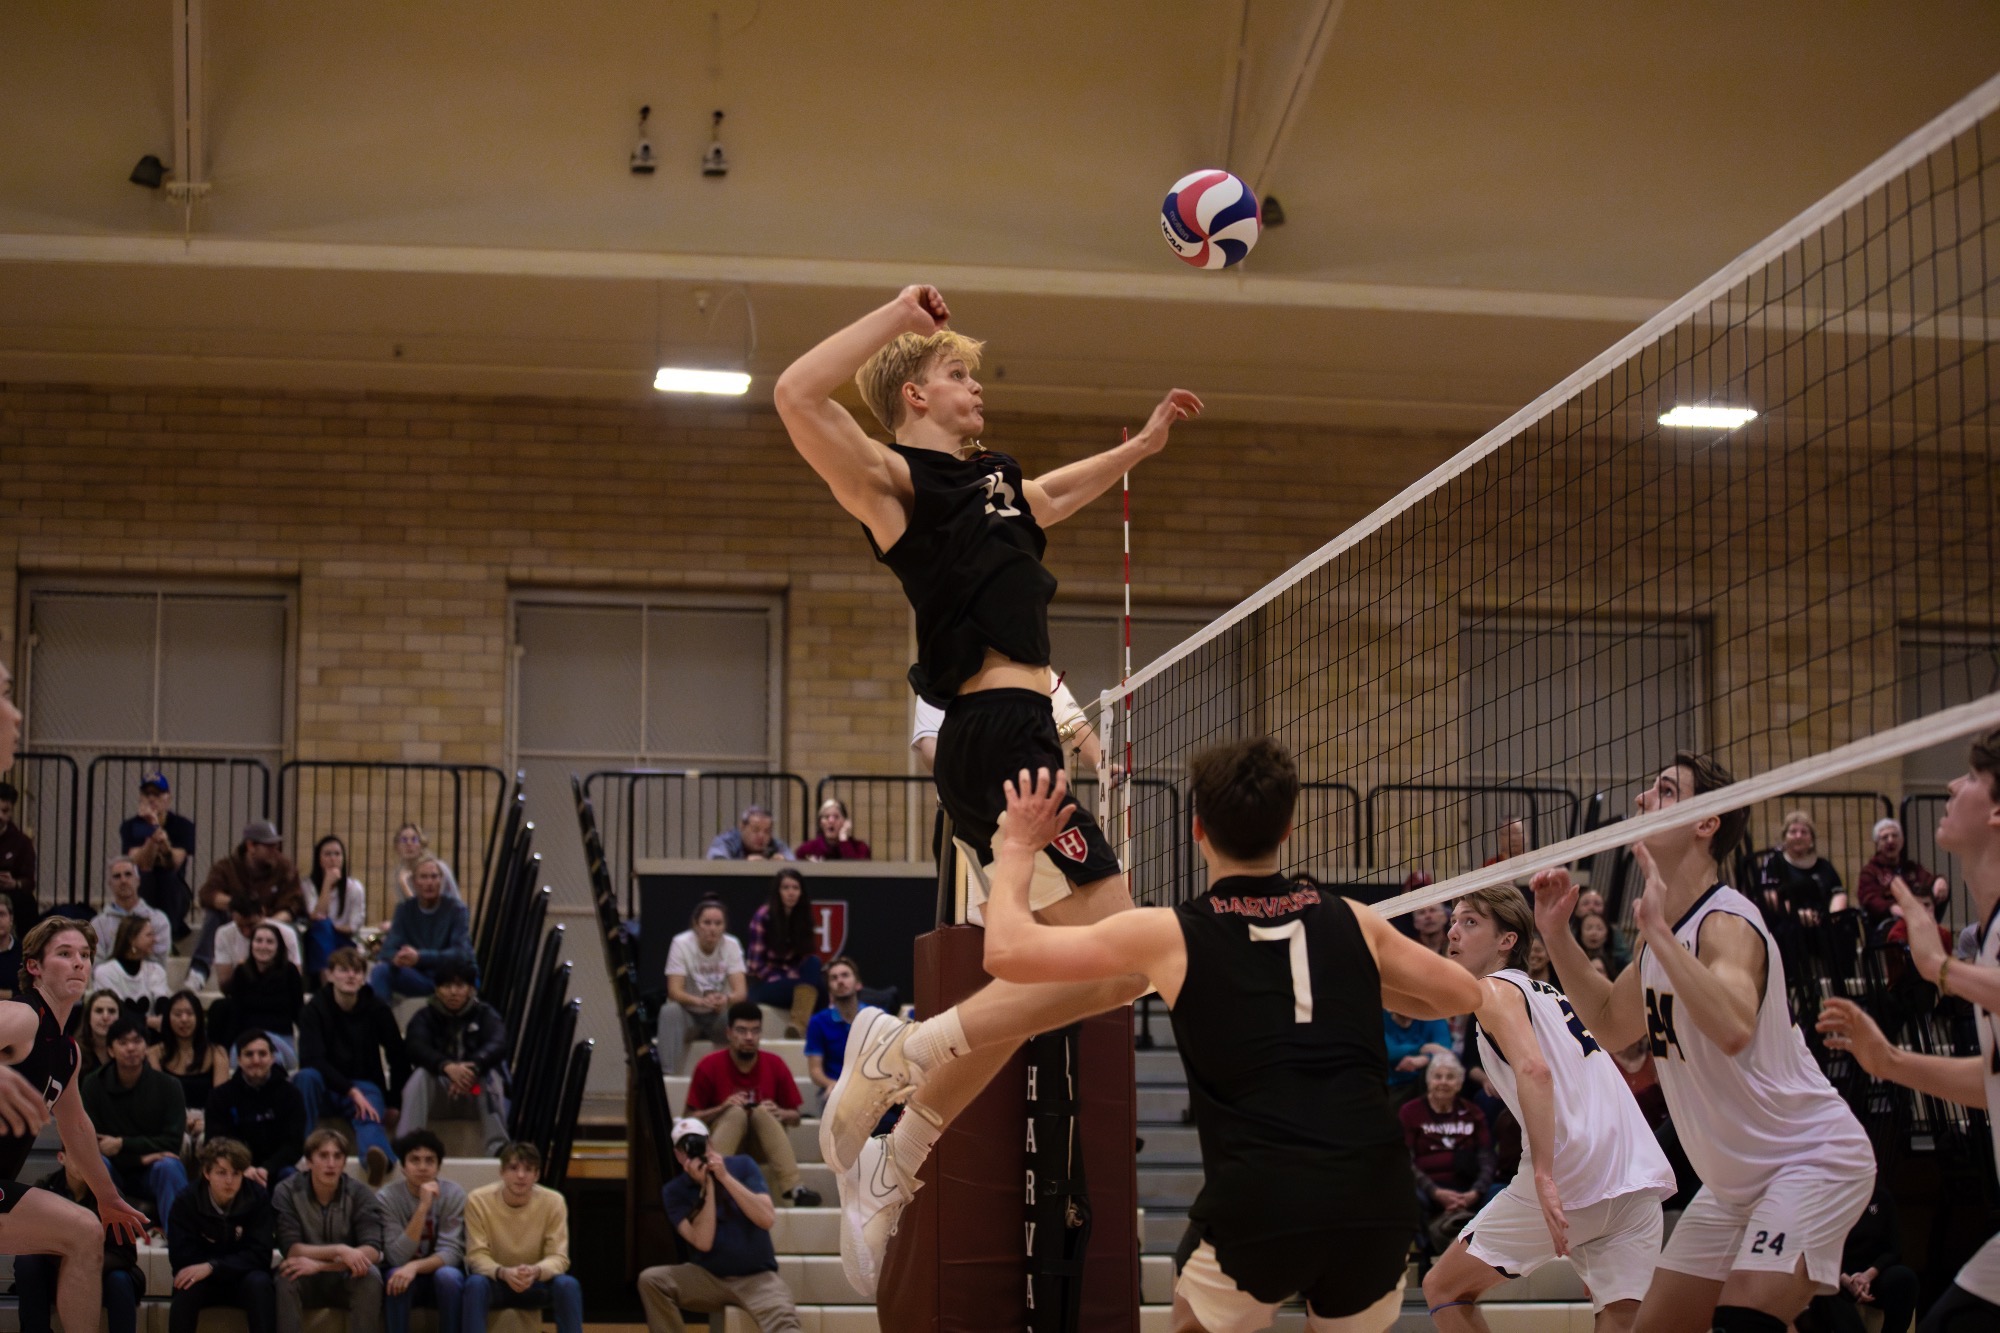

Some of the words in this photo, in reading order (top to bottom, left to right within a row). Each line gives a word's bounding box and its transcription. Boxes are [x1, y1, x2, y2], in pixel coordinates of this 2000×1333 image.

[1162, 220, 1185, 253] NCAA
[1059, 833, 1083, 856] H
[1248, 919, 1313, 1024] 7
[1025, 1065, 1038, 1333] HARVA
[1751, 1230, 1786, 1256] 24
